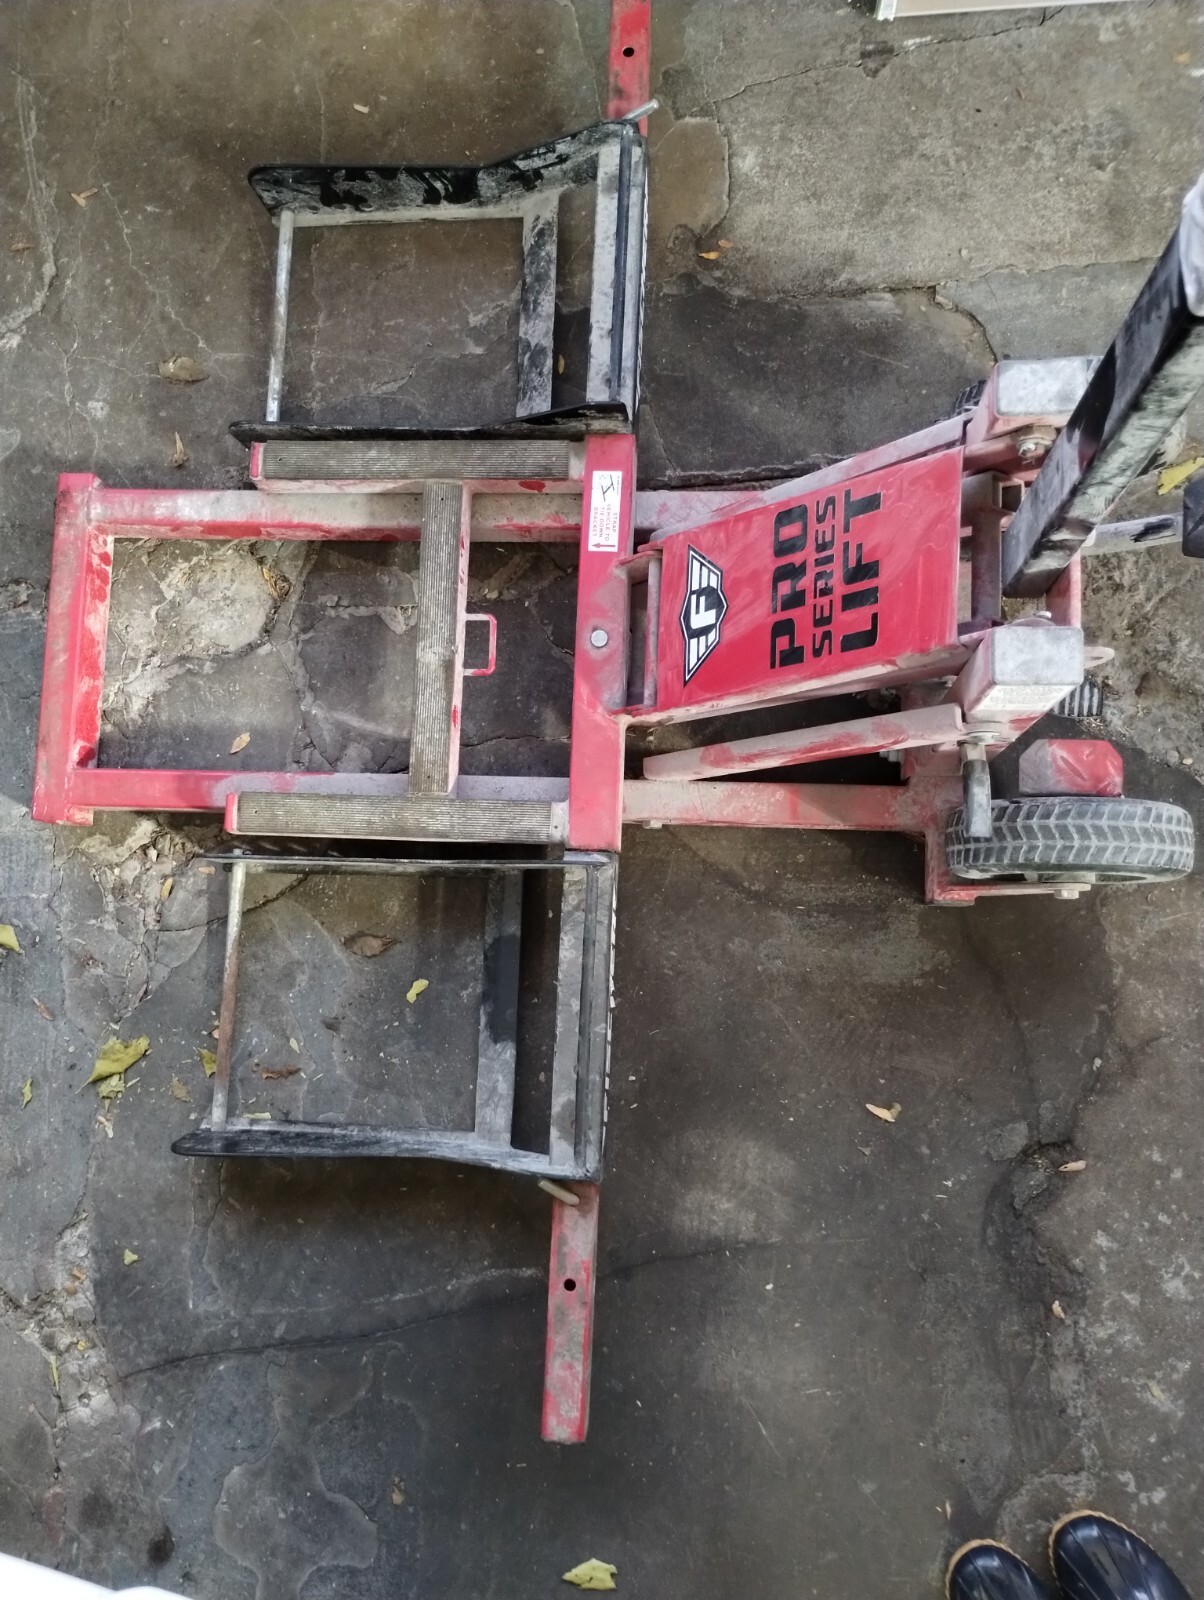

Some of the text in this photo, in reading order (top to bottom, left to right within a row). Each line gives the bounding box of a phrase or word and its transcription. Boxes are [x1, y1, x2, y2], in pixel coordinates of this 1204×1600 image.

[605, 533, 610, 542] TO
[770, 503, 808, 670] PRO
[812, 495, 836, 658] SERIES
[840, 488, 882, 653] LIFT
